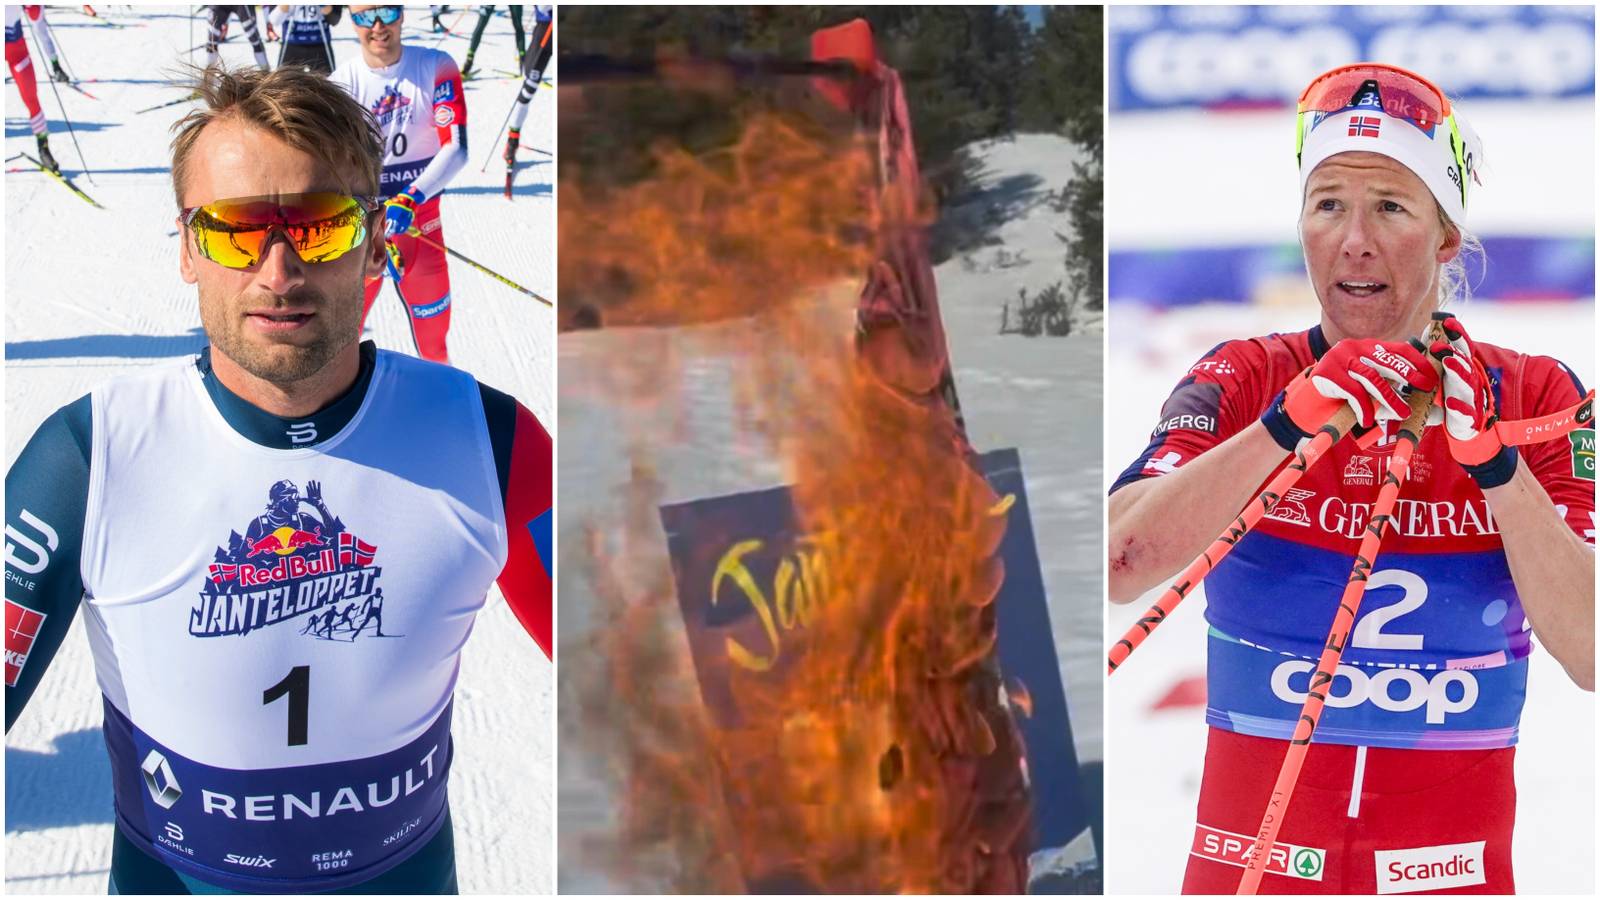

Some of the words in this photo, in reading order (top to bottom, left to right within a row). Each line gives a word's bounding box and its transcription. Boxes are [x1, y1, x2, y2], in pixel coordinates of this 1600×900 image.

[240, 556, 288, 587] Red
[289, 548, 336, 580] Bull
[189, 567, 382, 637] JANTELOPPET
[1352, 569, 1429, 651] 2
[263, 665, 310, 747] 1
[1271, 660, 1479, 724] coop
[202, 744, 438, 822] RENAULT
[312, 849, 353, 862] REMA
[317, 859, 348, 871] 1000
[1388, 854, 1475, 882] Scandic
